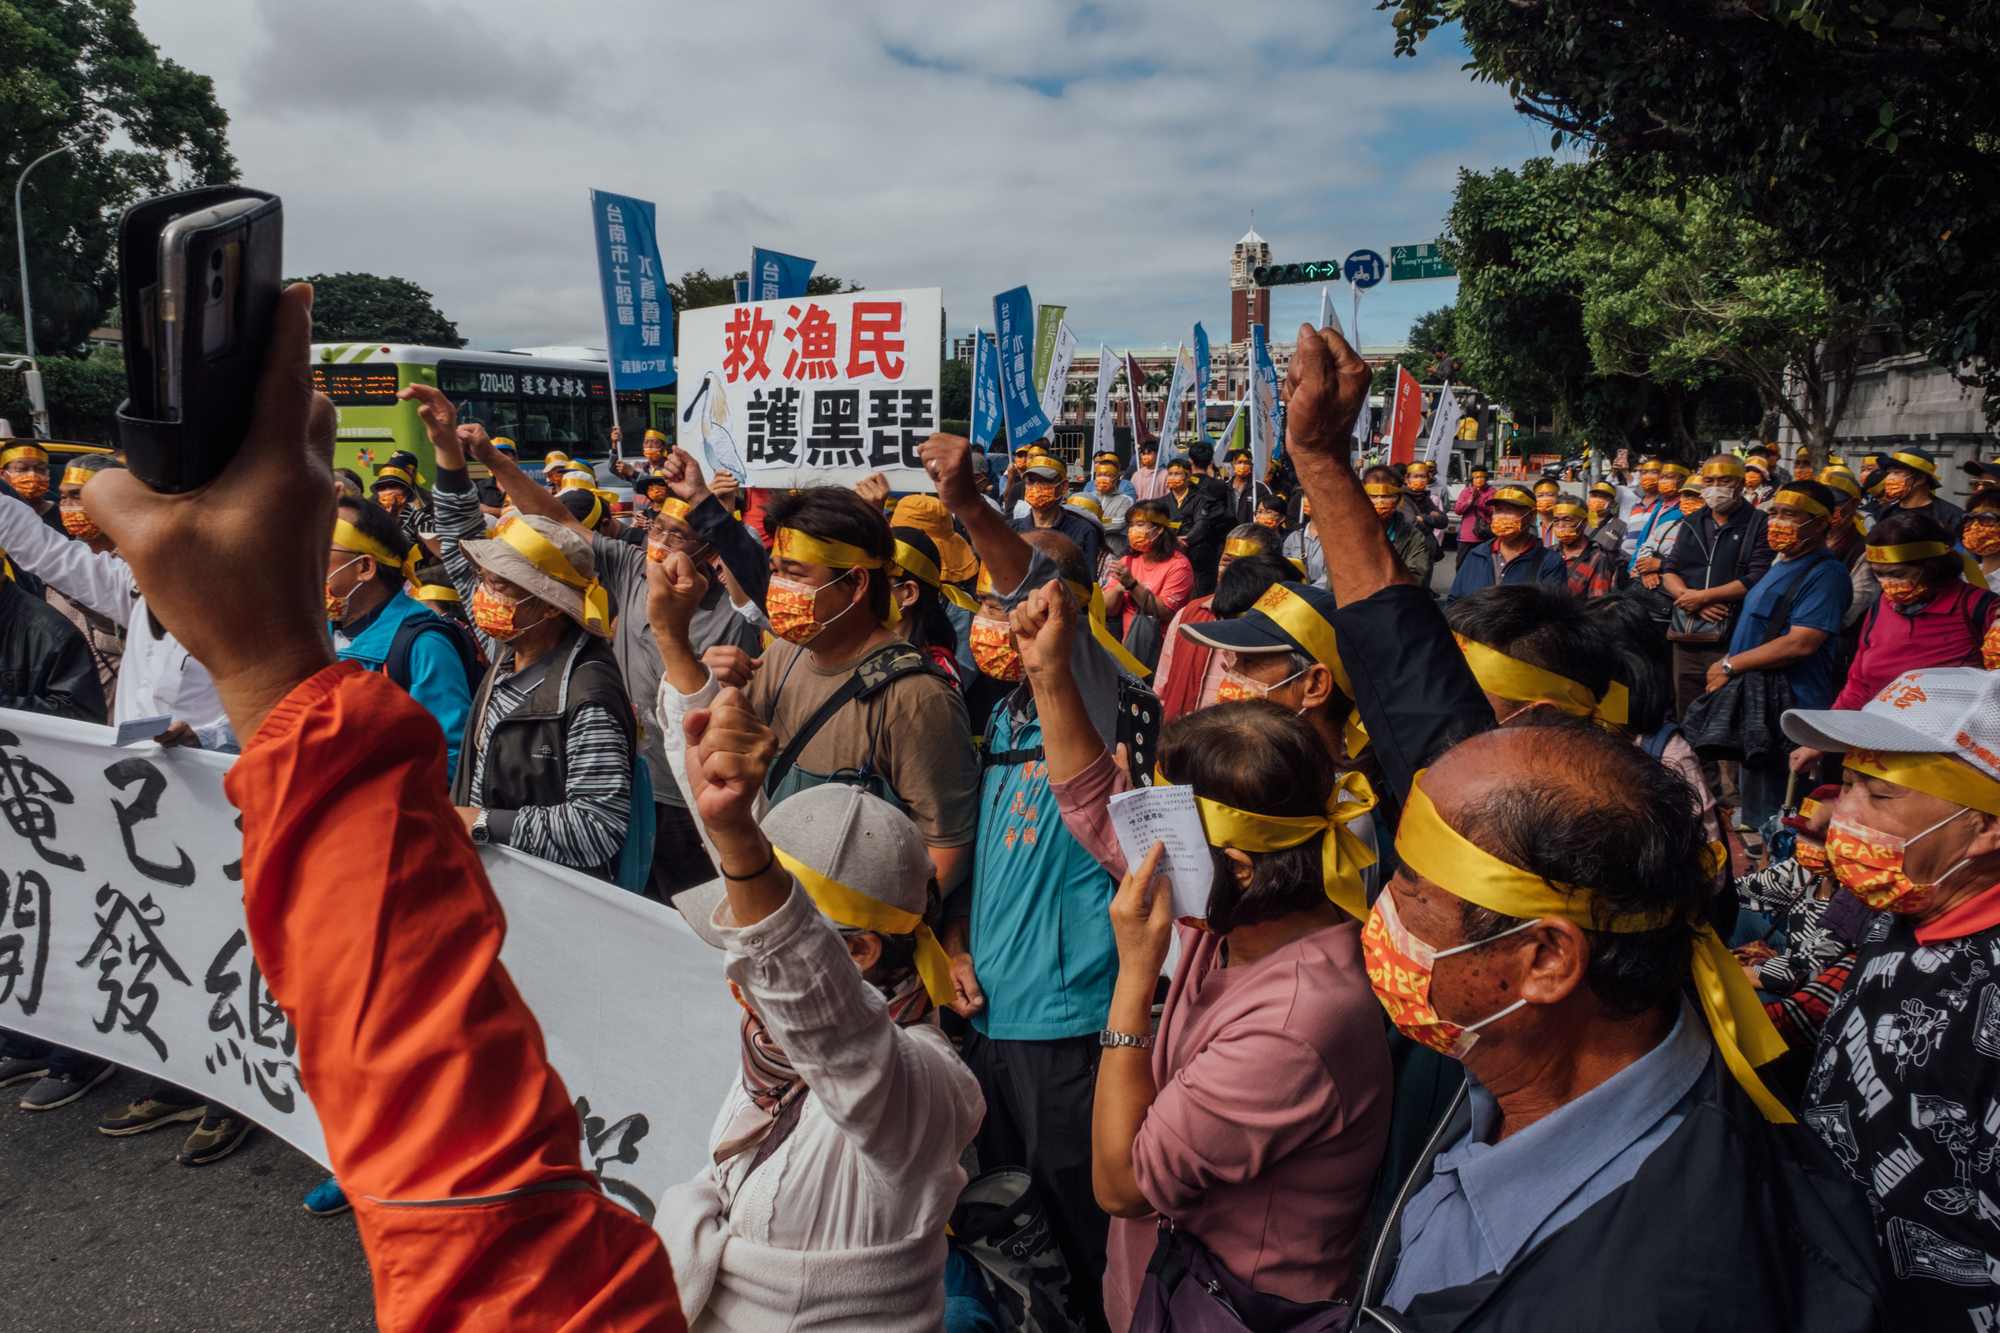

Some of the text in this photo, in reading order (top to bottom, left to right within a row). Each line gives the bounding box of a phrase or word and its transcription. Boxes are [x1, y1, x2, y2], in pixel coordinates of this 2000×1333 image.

[606, 203, 636, 326] 台南市七股區
[638, 254, 661, 347] 水產養殖
[479, 373, 515, 393] 270-U3
[722, 300, 905, 383] 救漁民
[746, 387, 934, 469] 護黑琵
[1836, 1005, 1893, 1122] PUMA
